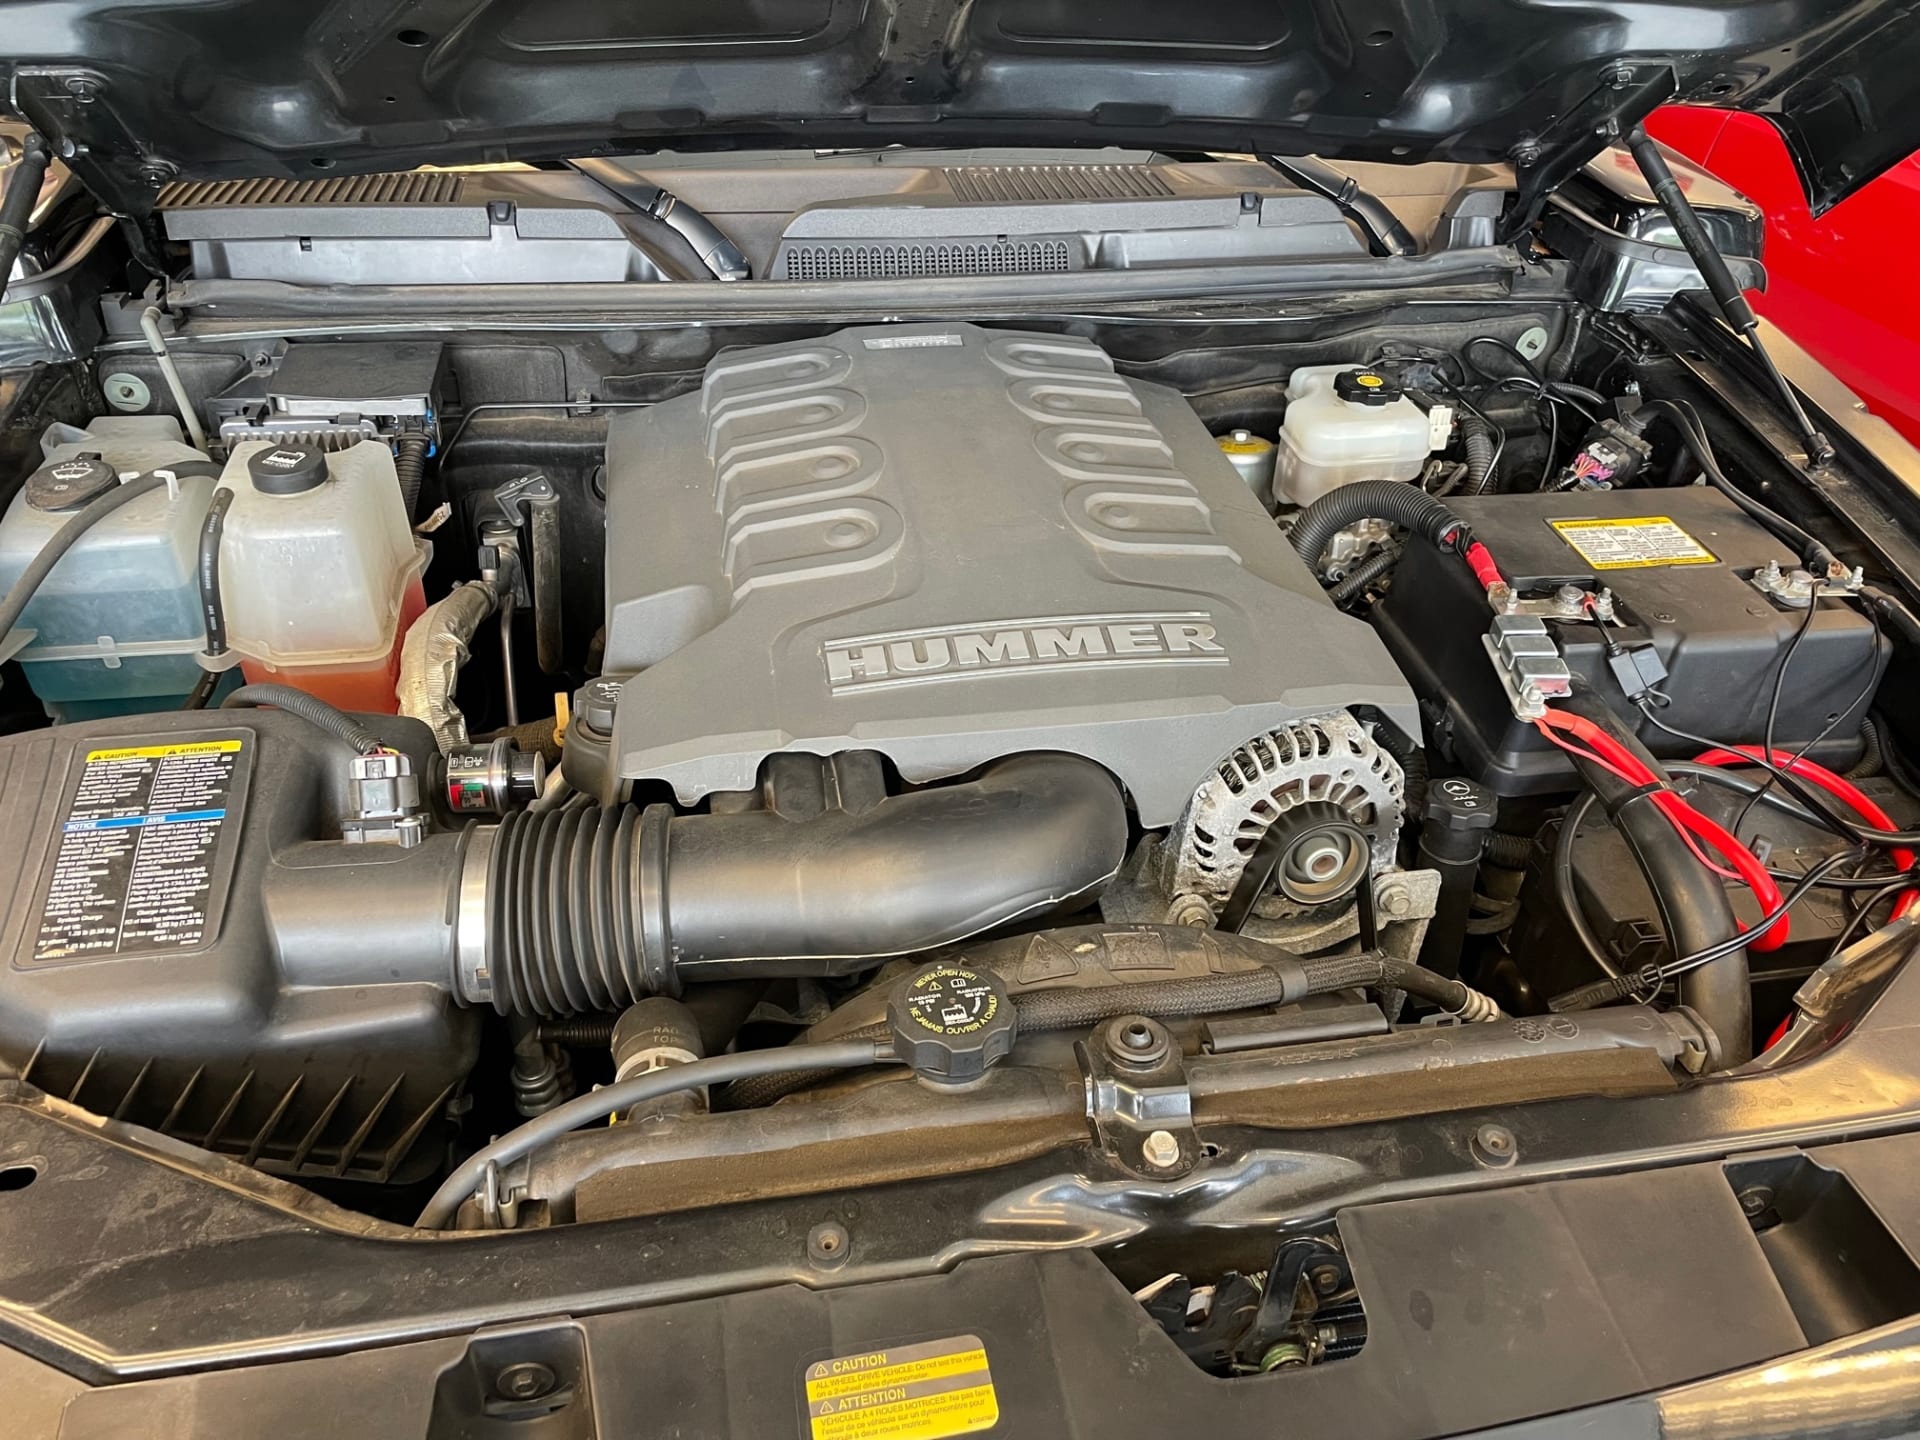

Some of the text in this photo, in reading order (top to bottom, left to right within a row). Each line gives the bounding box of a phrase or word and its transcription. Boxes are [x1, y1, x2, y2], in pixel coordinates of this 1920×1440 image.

[825, 622, 1226, 685] HUMMER
[104, 751, 138, 760] CAUTION
[180, 746, 222, 754] ATTENTION
[914, 968, 978, 988] NEVER OPEN HOT!
[909, 1007, 921, 1018] NE
[916, 1014, 944, 1034] JAMAIS
[946, 1022, 982, 1034] OUVRIR
[654, 1035, 678, 1044] TOP
[832, 1352, 888, 1373] CAUTION
[816, 1380, 830, 1390] ALL
[830, 1375, 856, 1387] WHEEL
[857, 1372, 880, 1382] DRIVE
[915, 1363, 926, 1371] Do
[926, 1361, 937, 1369] not
[838, 1388, 906, 1411] ATTENTION
[875, 1404, 903, 1416] ROUES
